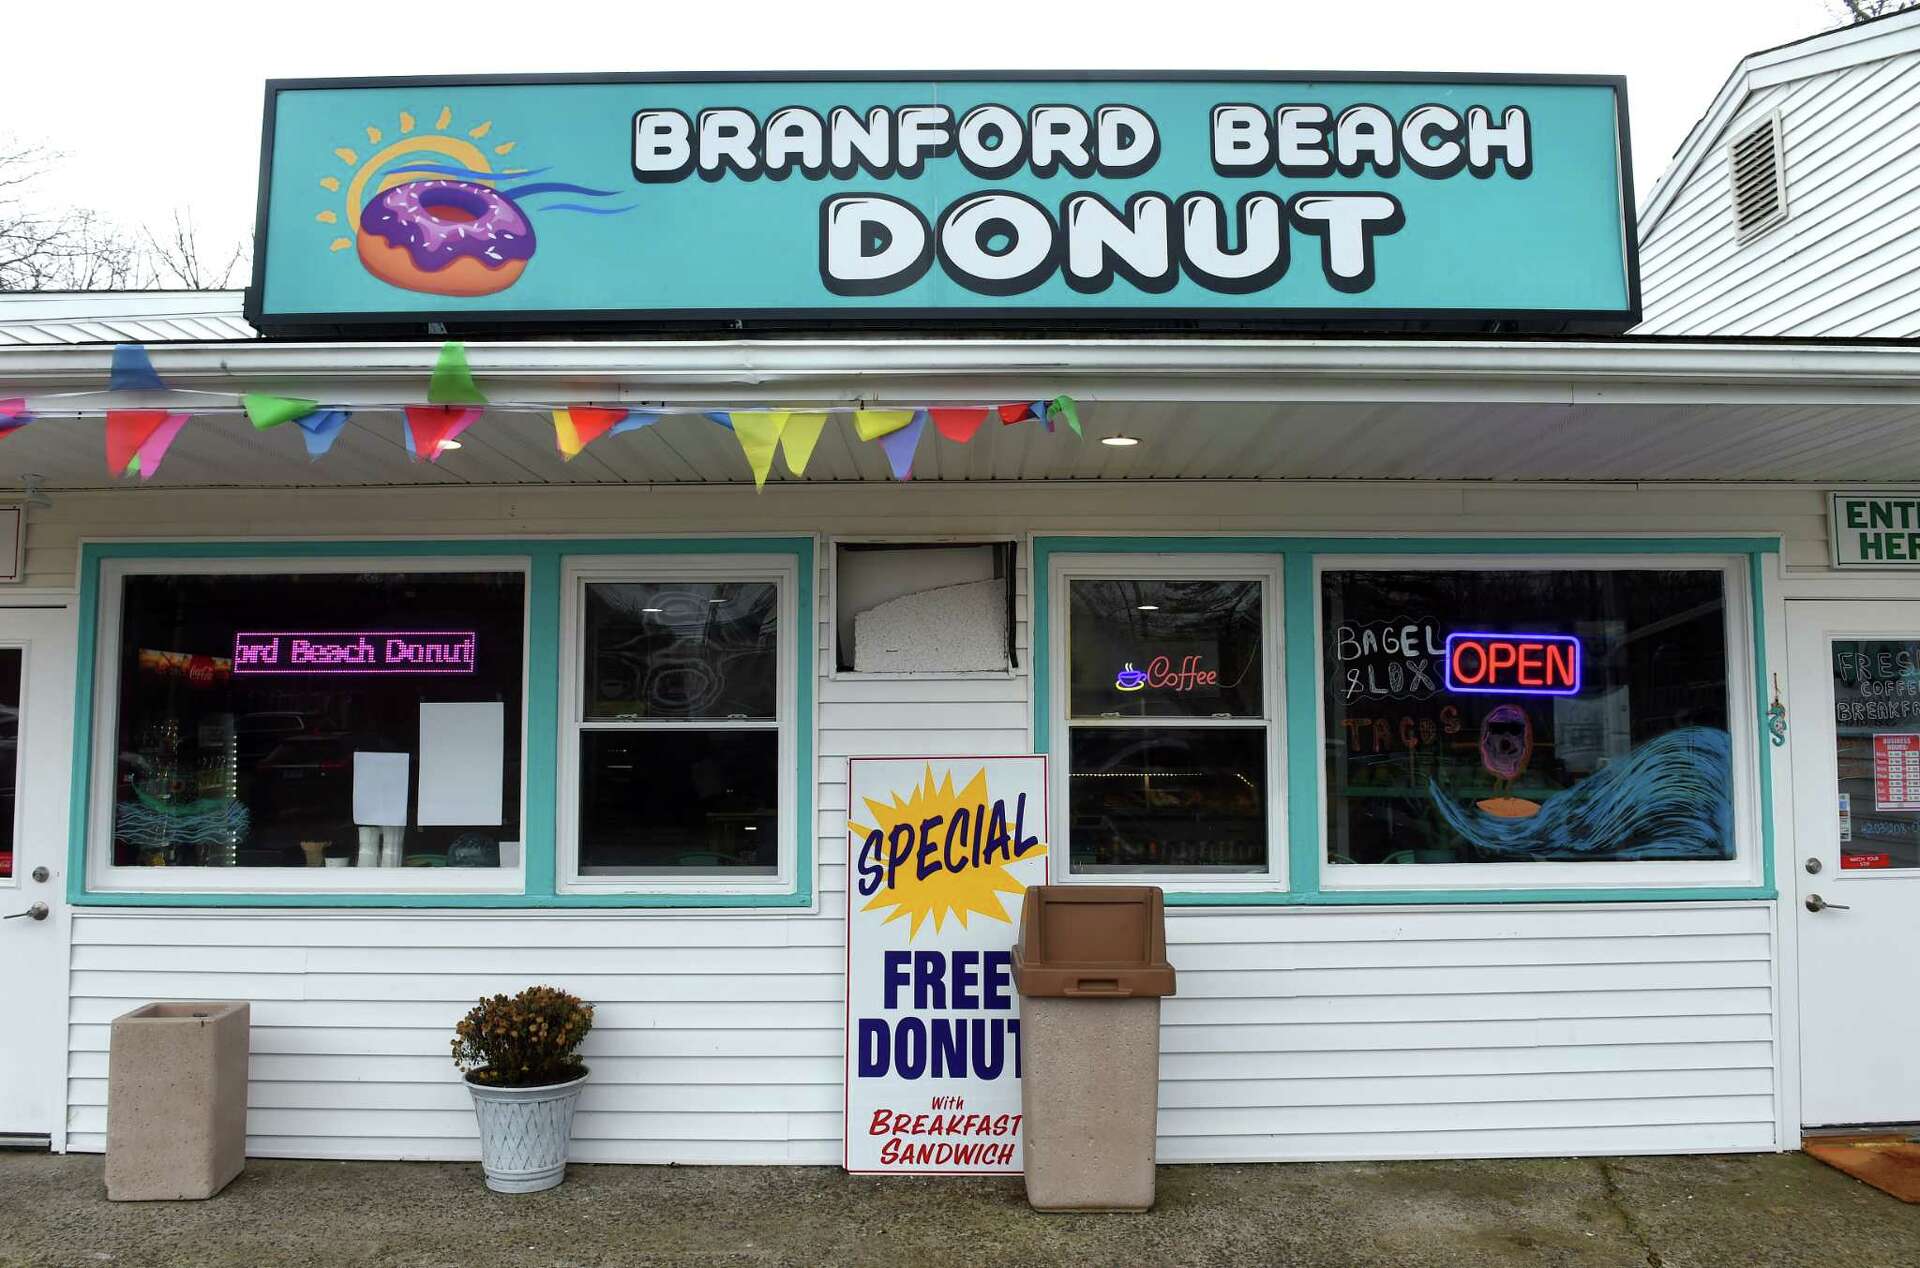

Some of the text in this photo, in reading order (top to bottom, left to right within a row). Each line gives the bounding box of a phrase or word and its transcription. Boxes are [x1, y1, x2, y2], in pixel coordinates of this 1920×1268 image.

[632, 103, 1533, 183] BRANFORD BEACH
[819, 189, 1406, 296] DONUT
[1847, 501, 1920, 528] ENT
[291, 637, 376, 663] Beach
[386, 639, 473, 663] Donut
[1338, 625, 1447, 660] BAGEL
[1147, 655, 1216, 691] Coffee
[1451, 641, 1576, 687] OPEN
[1838, 650, 1920, 681] FRES
[1861, 680, 1920, 697] COFFE
[1343, 705, 1461, 752] TACOS
[858, 792, 1038, 896] SPECIAL
[884, 950, 1012, 1010] FREE
[858, 1016, 1022, 1080] DONUT
[931, 1096, 964, 1110] With
[869, 1109, 1023, 1136] BREAKFAST
[880, 1137, 1015, 1165] SANDWICH
